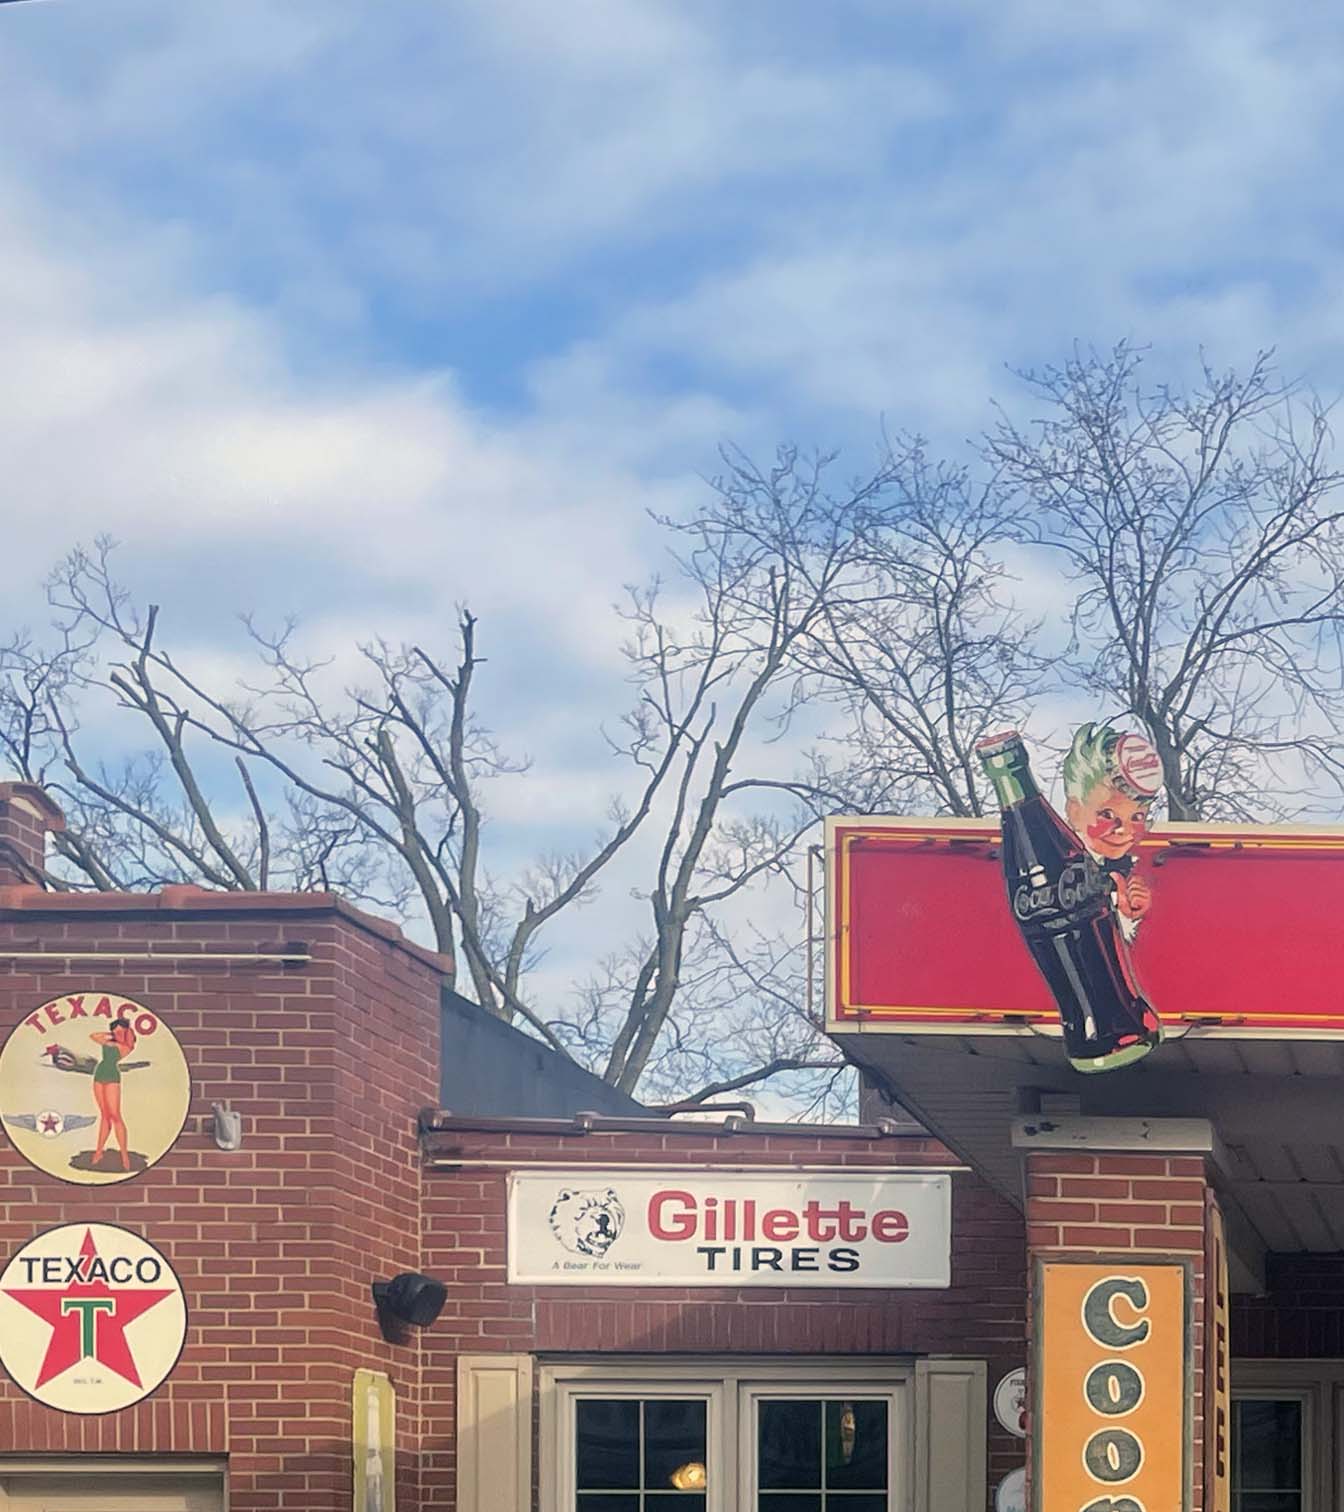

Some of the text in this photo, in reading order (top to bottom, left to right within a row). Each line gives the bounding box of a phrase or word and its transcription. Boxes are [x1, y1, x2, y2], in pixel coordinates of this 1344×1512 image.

[24, 995, 158, 1036] TEXACO
[647, 1189, 909, 1243] Gillette
[20, 1256, 161, 1284] TEXACO
[697, 1247, 860, 1272] TIRES
